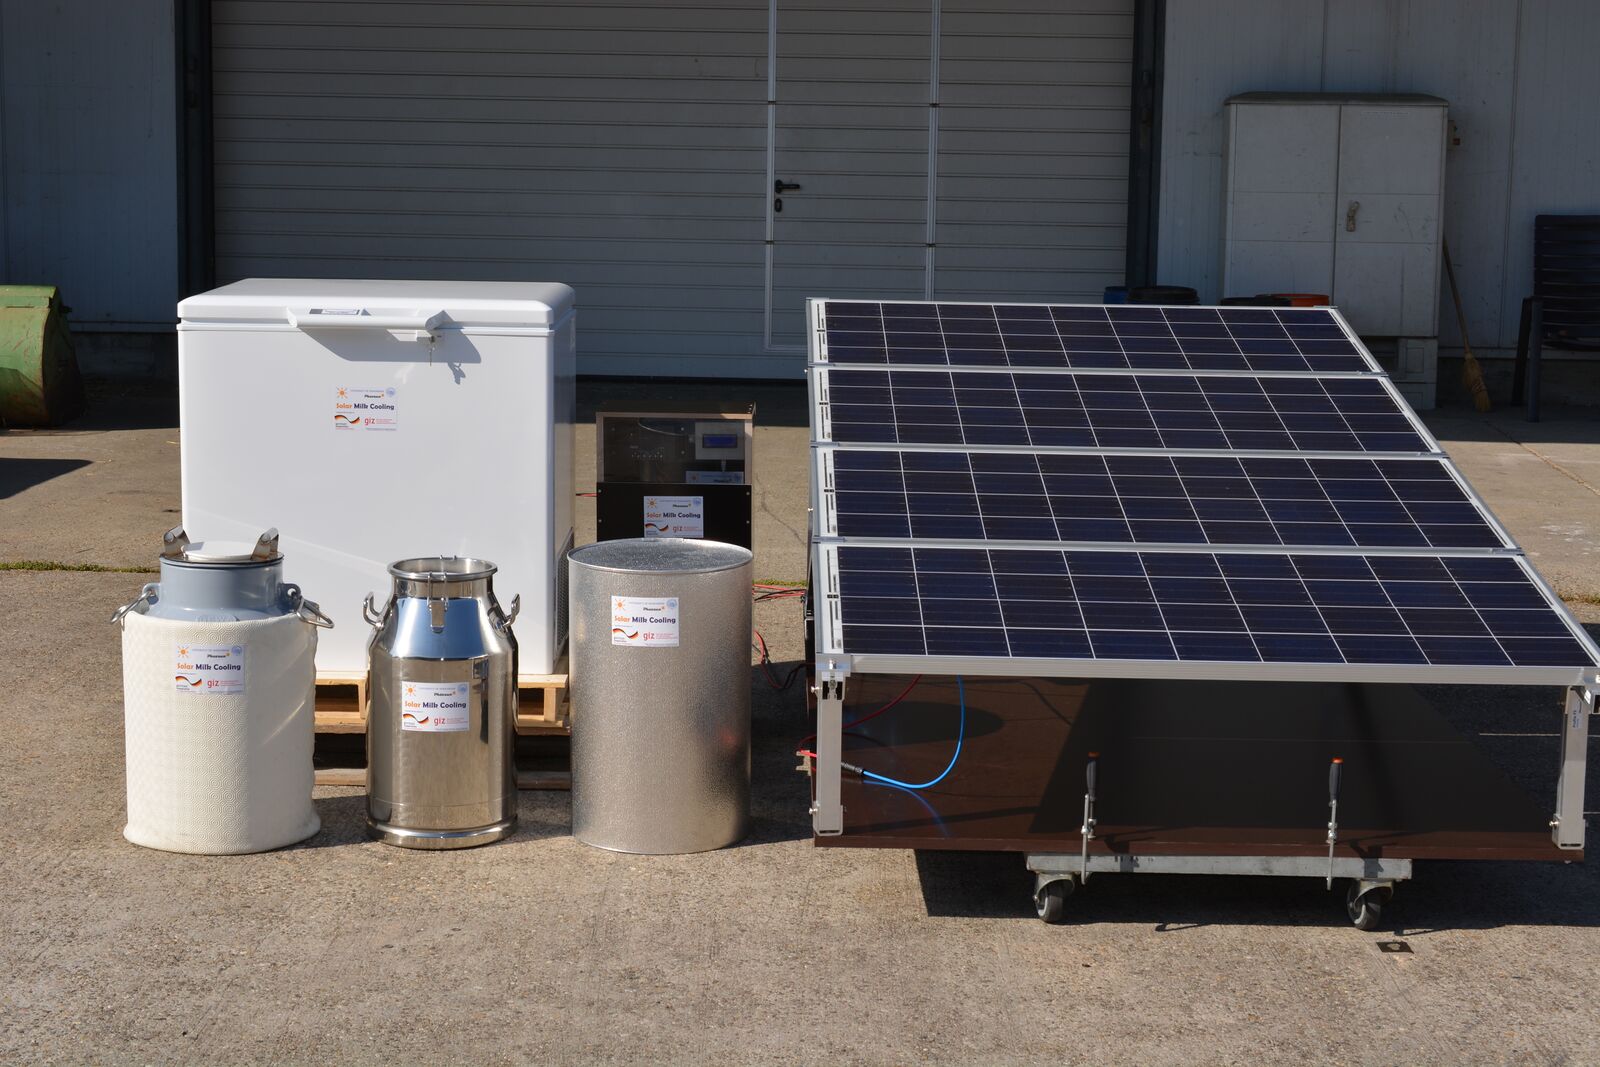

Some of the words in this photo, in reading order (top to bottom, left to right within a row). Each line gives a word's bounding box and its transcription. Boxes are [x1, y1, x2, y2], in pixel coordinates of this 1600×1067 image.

[643, 632, 655, 640] giz
[208, 680, 220, 688] giz
[434, 718, 446, 726] giz
